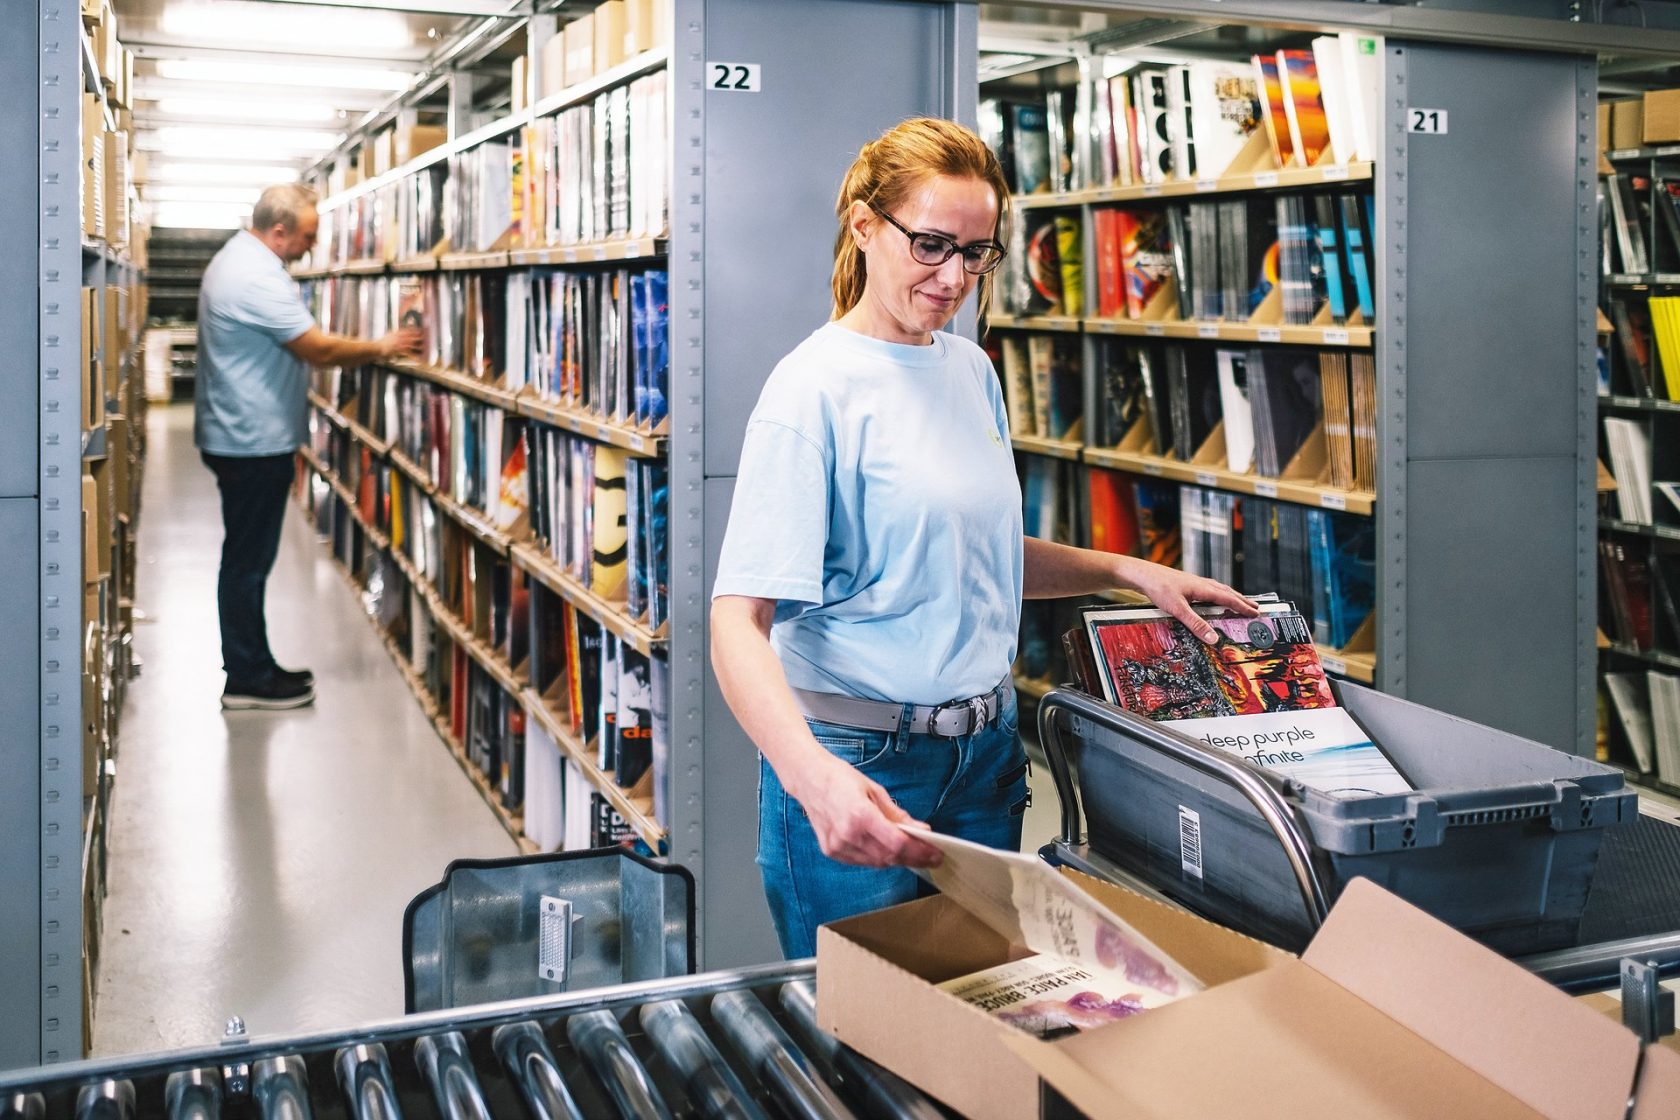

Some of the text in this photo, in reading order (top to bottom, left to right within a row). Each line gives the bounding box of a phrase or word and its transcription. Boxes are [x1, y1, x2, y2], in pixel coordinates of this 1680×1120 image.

[715, 65, 750, 89] 22
[1414, 111, 1438, 131] 21
[1253, 726, 1315, 749] purple
[1031, 977, 1069, 997] PAICE
